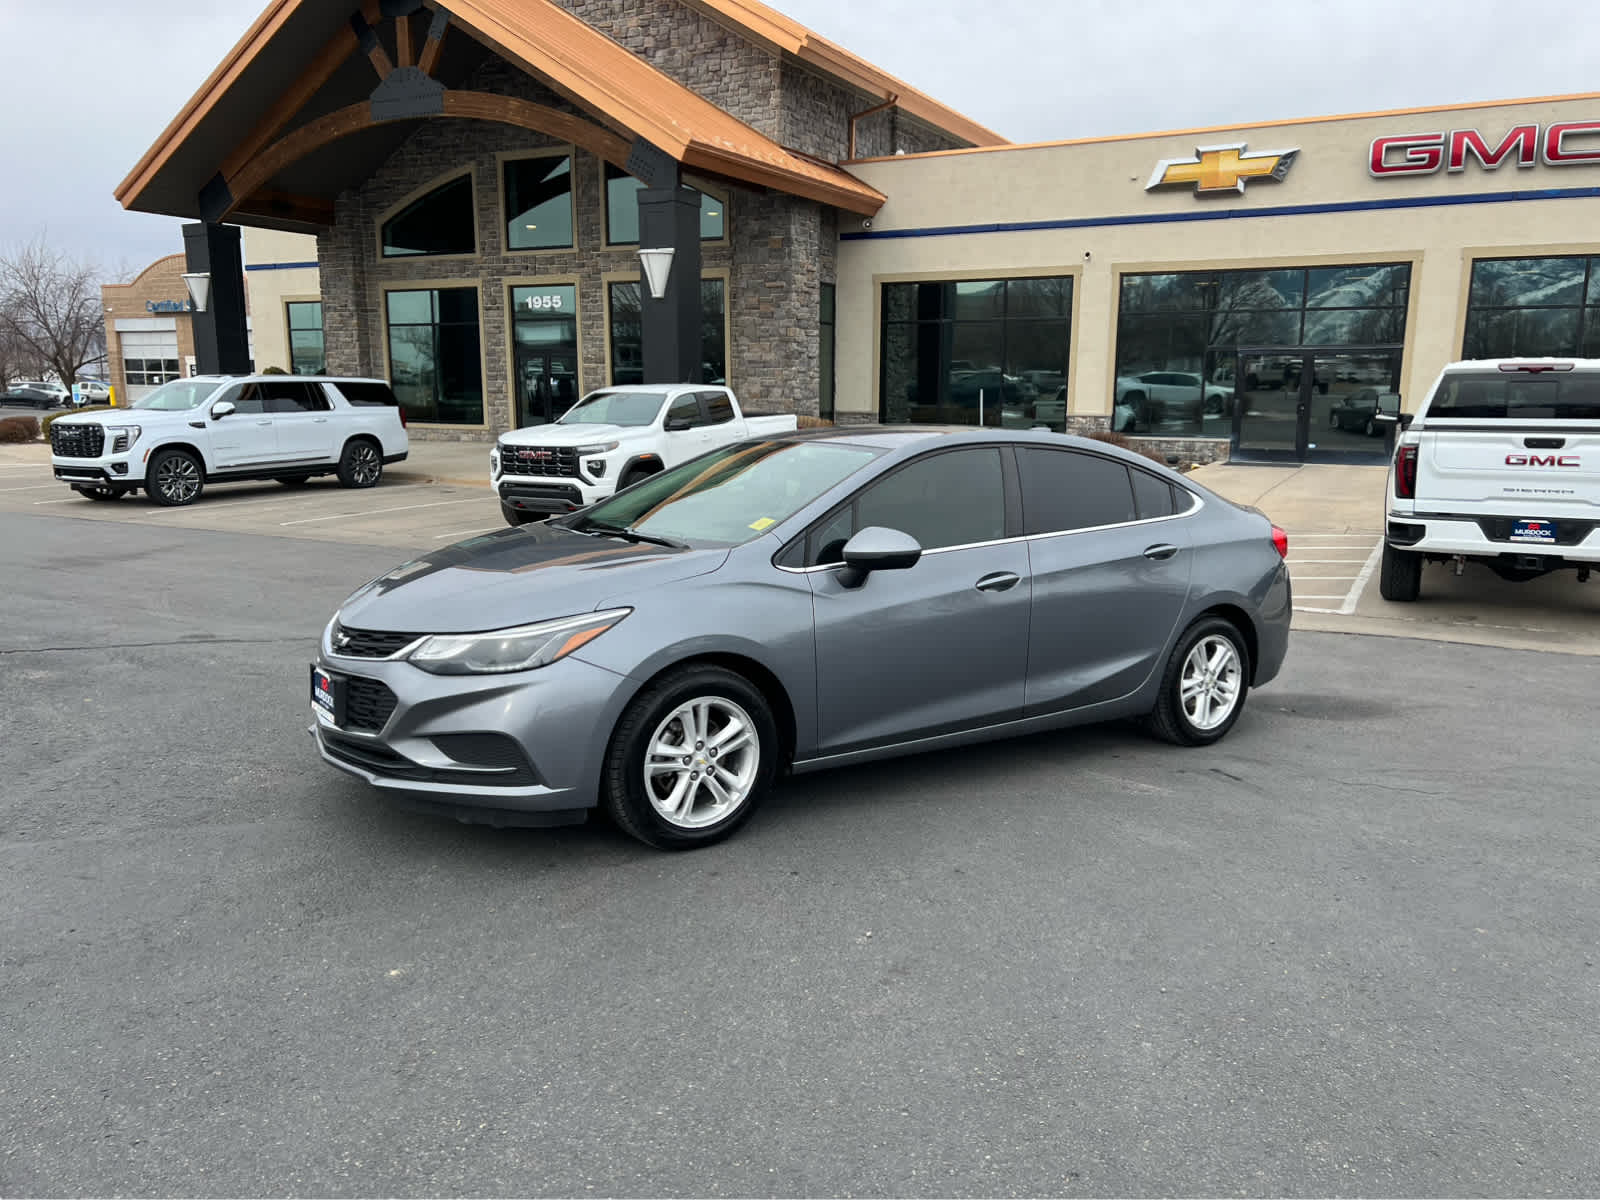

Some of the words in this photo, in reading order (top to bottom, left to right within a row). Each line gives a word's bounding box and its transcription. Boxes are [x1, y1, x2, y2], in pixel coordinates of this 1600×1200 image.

[1369, 120, 1600, 177] GMC
[526, 295, 562, 309] 1955
[519, 450, 552, 460] GMC
[1505, 455, 1581, 467] GMC
